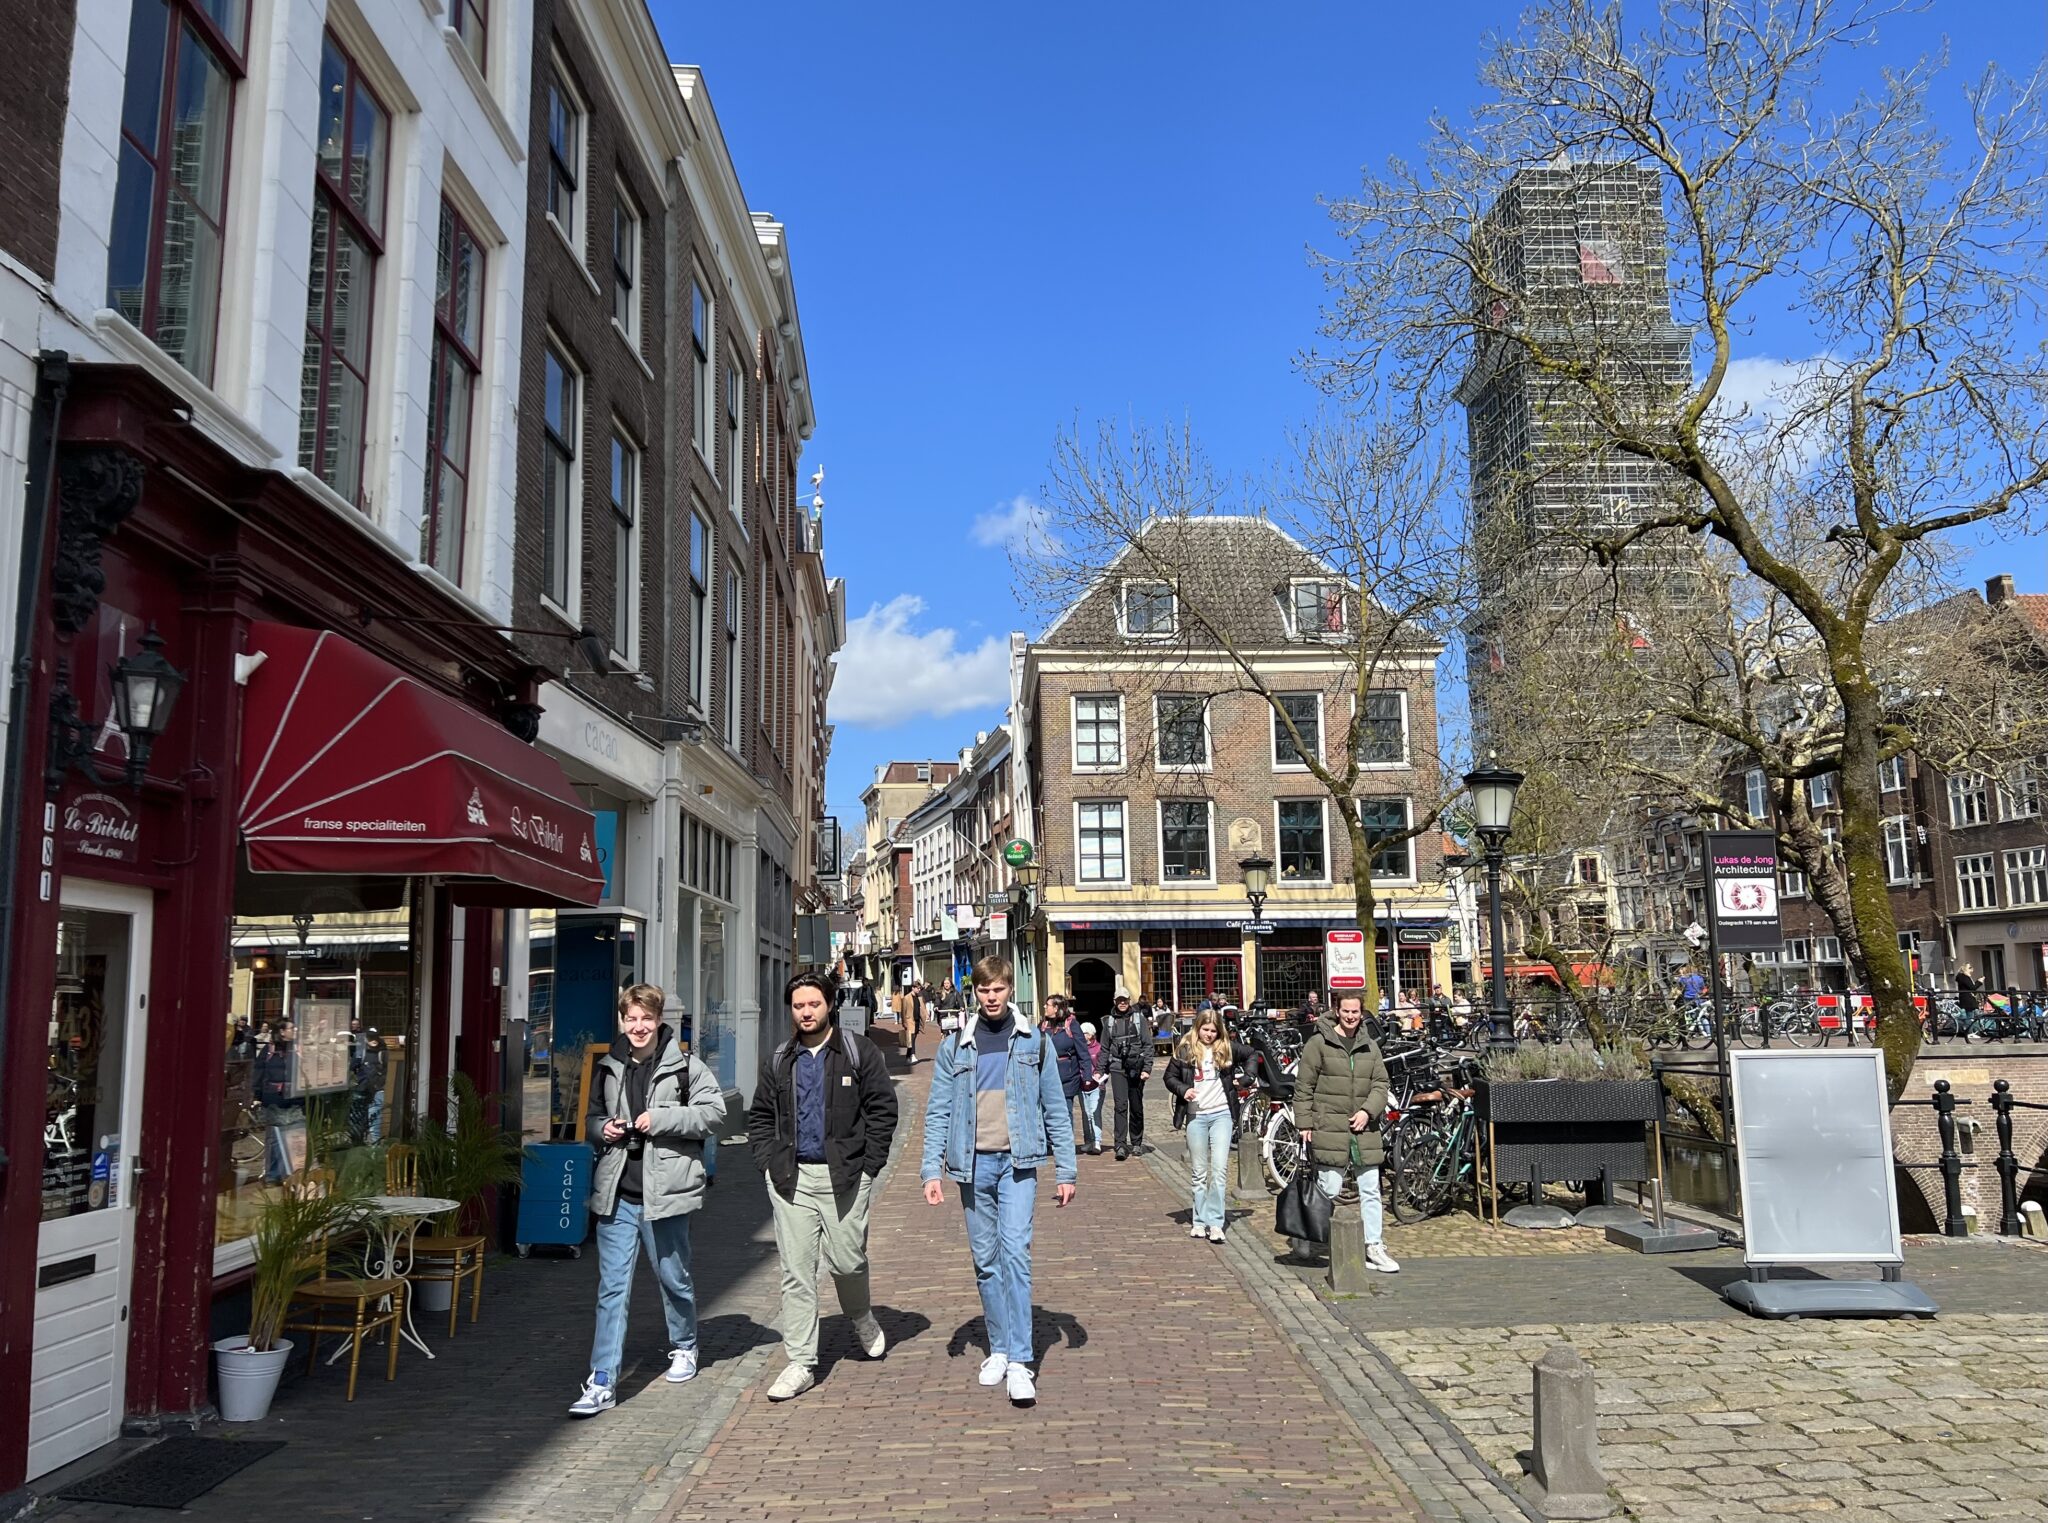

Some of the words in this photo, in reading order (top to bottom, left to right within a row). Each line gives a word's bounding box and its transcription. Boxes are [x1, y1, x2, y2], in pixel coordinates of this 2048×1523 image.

[585, 722, 618, 761] cacao
[64, 807, 82, 831] Le
[85, 812, 138, 842] Bibelot
[304, 818, 343, 830] franse
[346, 820, 426, 832] specialiteiten
[467, 804, 489, 827] SPA
[511, 806, 528, 840] Le
[580, 847, 592, 864] SPA
[1714, 856, 1739, 864] Lukas
[1740, 856, 1752, 864] de
[1753, 856, 1773, 865] Jong
[1714, 866, 1773, 874] Architectuur
[560, 1160, 574, 1228] cacao
